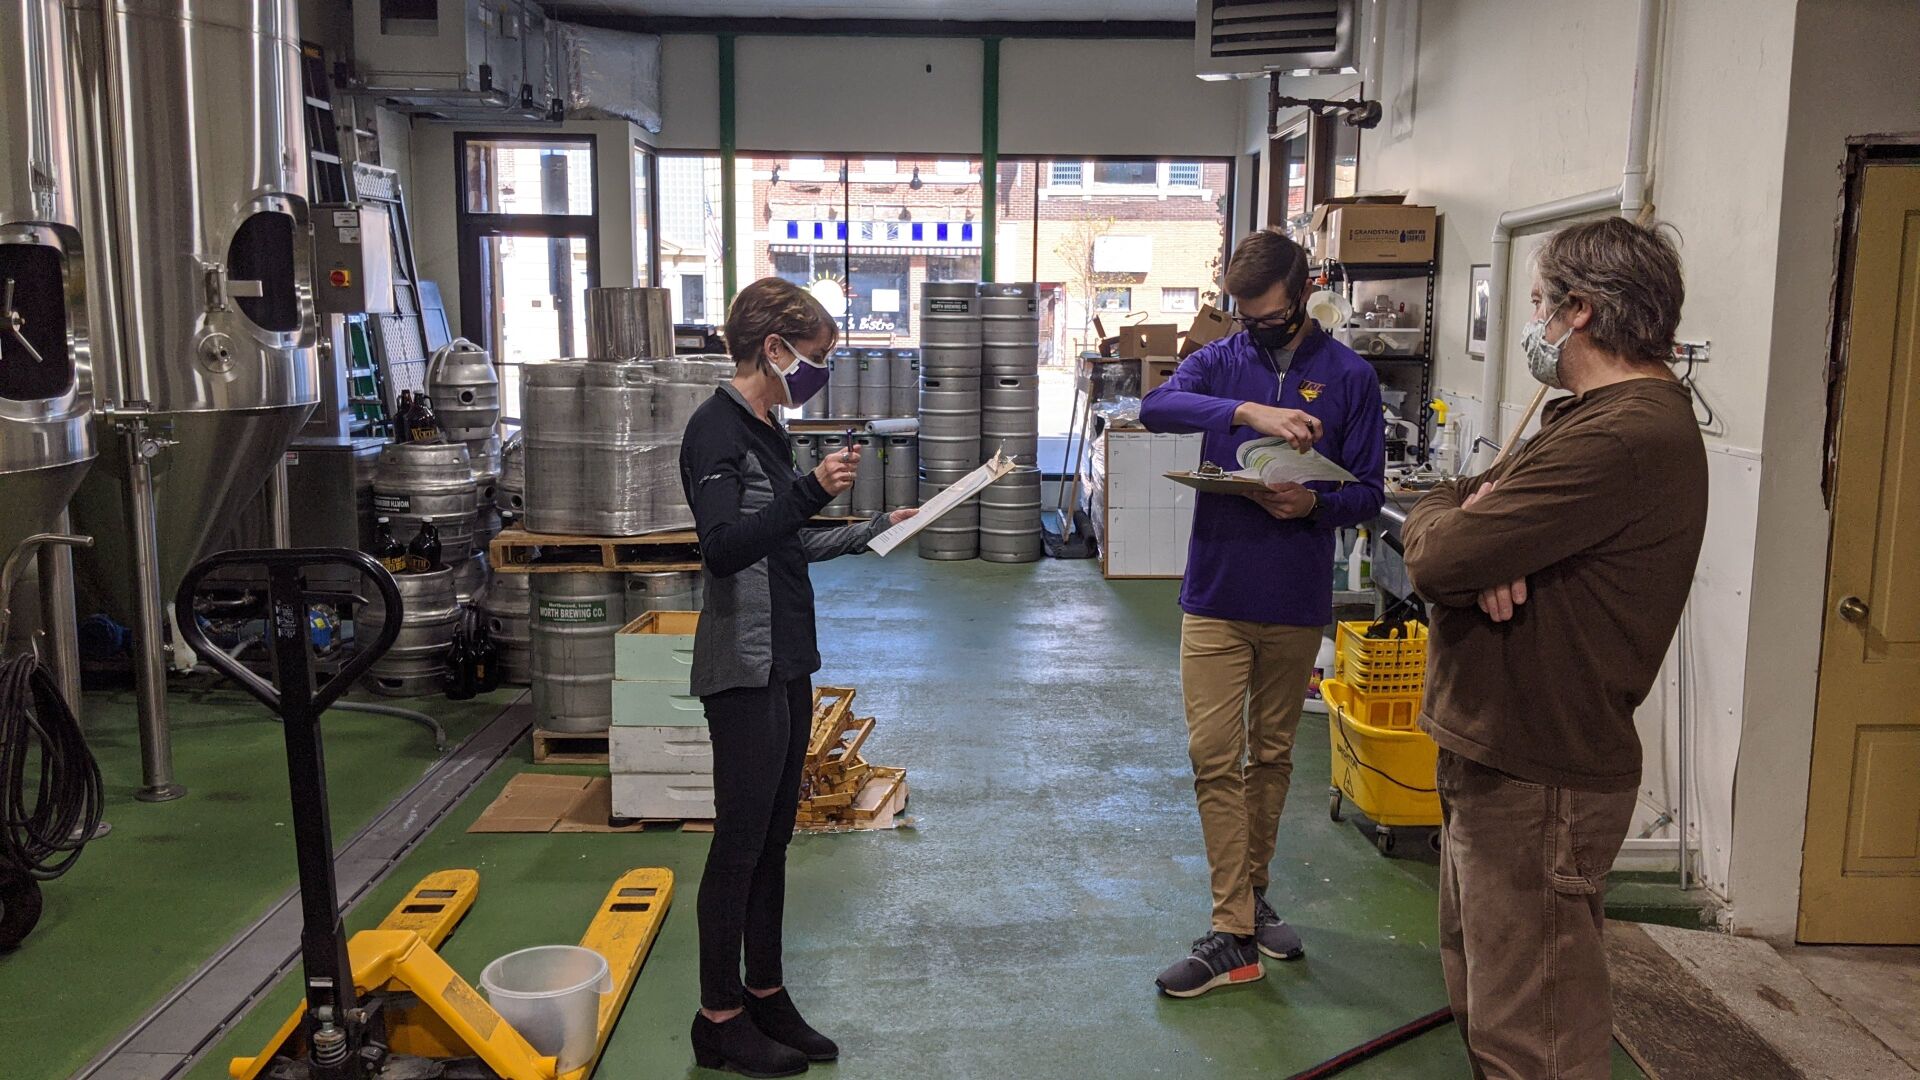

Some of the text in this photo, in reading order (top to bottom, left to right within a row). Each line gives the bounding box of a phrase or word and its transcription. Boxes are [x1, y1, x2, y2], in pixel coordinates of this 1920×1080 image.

[859, 314, 895, 330] Bistro
[390, 500, 410, 508] WORTH
[539, 607, 605, 618] WORTH BREWING CO.
